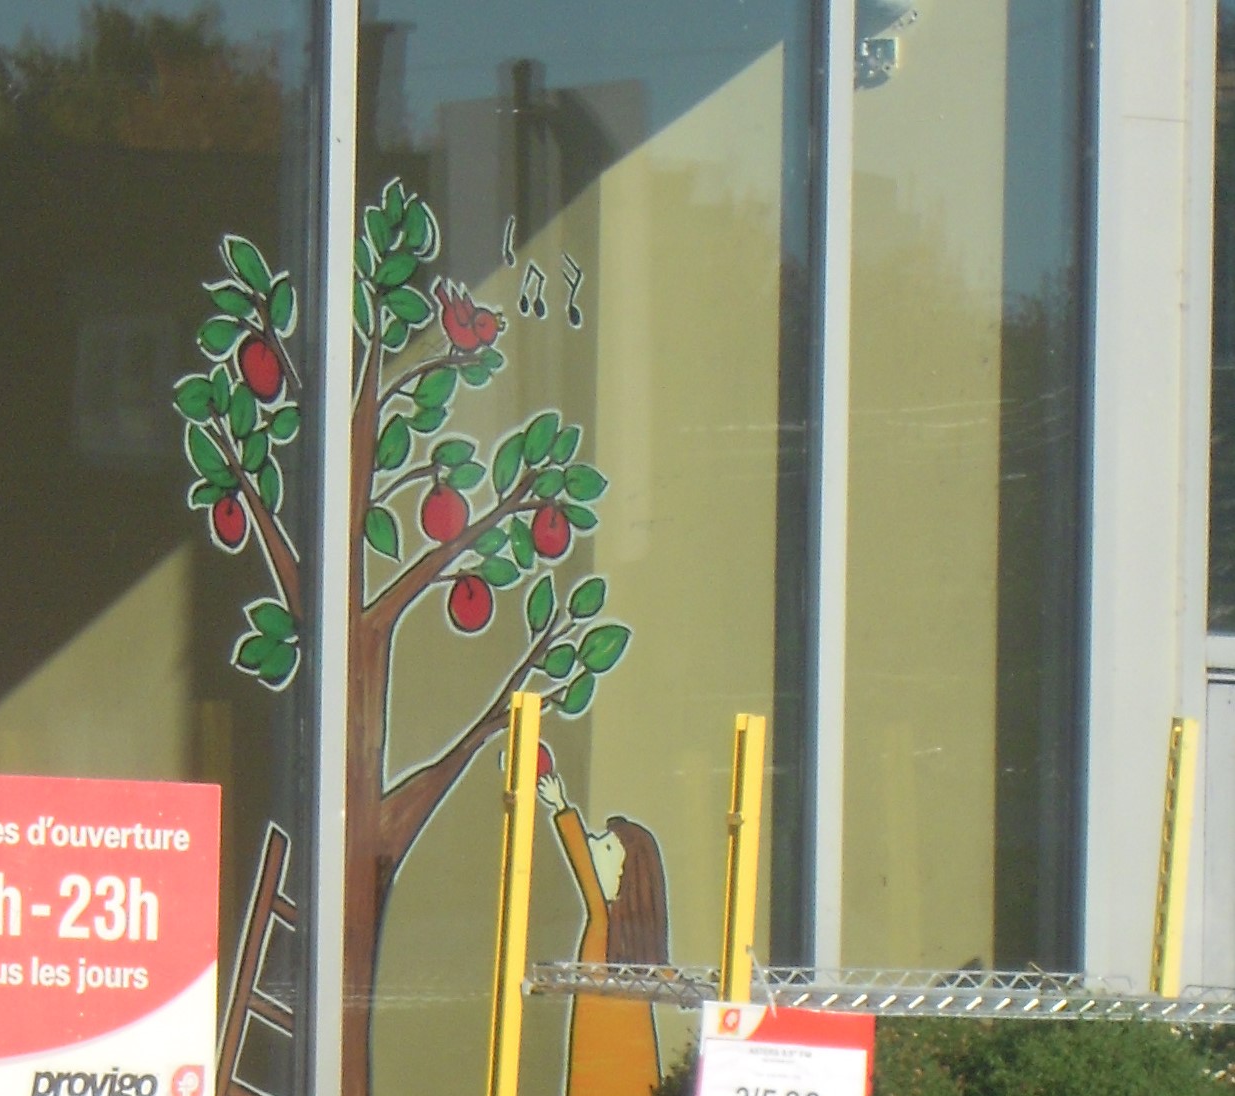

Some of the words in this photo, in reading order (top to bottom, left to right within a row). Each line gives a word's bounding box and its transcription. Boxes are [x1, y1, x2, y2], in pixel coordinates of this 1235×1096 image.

[27, 816, 190, 851] d'ouverture
[31, 956, 71, 988] les
[76, 957, 149, 994] jours
